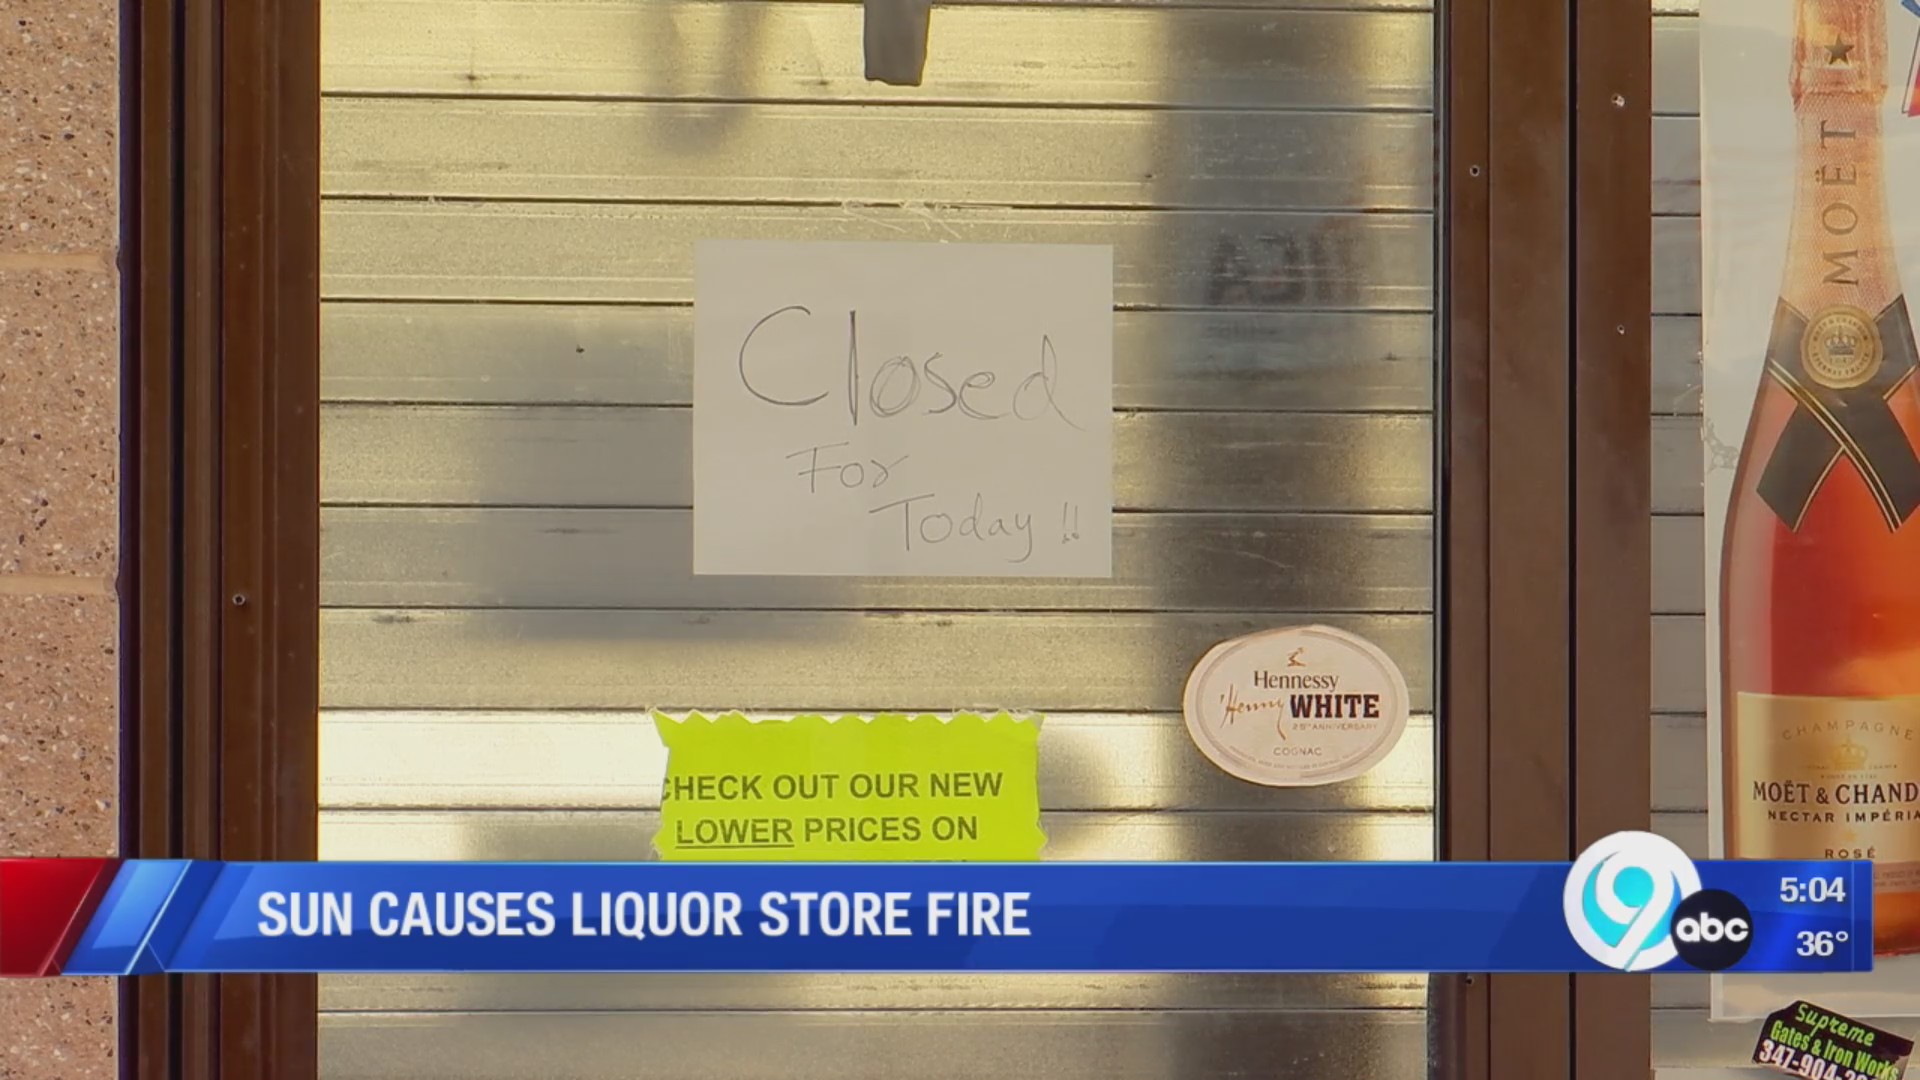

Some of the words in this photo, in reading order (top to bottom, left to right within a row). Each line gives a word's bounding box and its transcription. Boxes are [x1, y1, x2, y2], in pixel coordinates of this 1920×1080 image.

[1815, 120, 1860, 286] MOËT
[738, 305, 1086, 432] Closed
[785, 441, 910, 493] For
[869, 492, 1033, 563] Today
[1253, 671, 1339, 692] Hennessy
[1290, 694, 1380, 718] WHITE
[1782, 719, 1913, 741] CHAMPAGNE
[1273, 747, 1322, 756] COGNAC
[773, 774, 839, 799] OUT
[849, 773, 918, 798] OUR
[930, 772, 1002, 797] NEW
[1753, 780, 1810, 803] MOËT
[1816, 787, 1829, 804] &
[1835, 782, 1919, 804] CHAND
[1768, 810, 1834, 822] NECTAR
[675, 818, 793, 849] LOWER
[804, 817, 921, 842] PRICES
[932, 816, 977, 840] ON
[1825, 847, 1876, 859] ROSÉ
[1795, 1003, 1875, 1047] Supreme
[1759, 1039, 1877, 1080] 347-904-
[1770, 1020, 1811, 1051] Gates
[1811, 1039, 1822, 1056] &
[1823, 1039, 1854, 1068] Iron
[1854, 1050, 1900, 1080] Works
